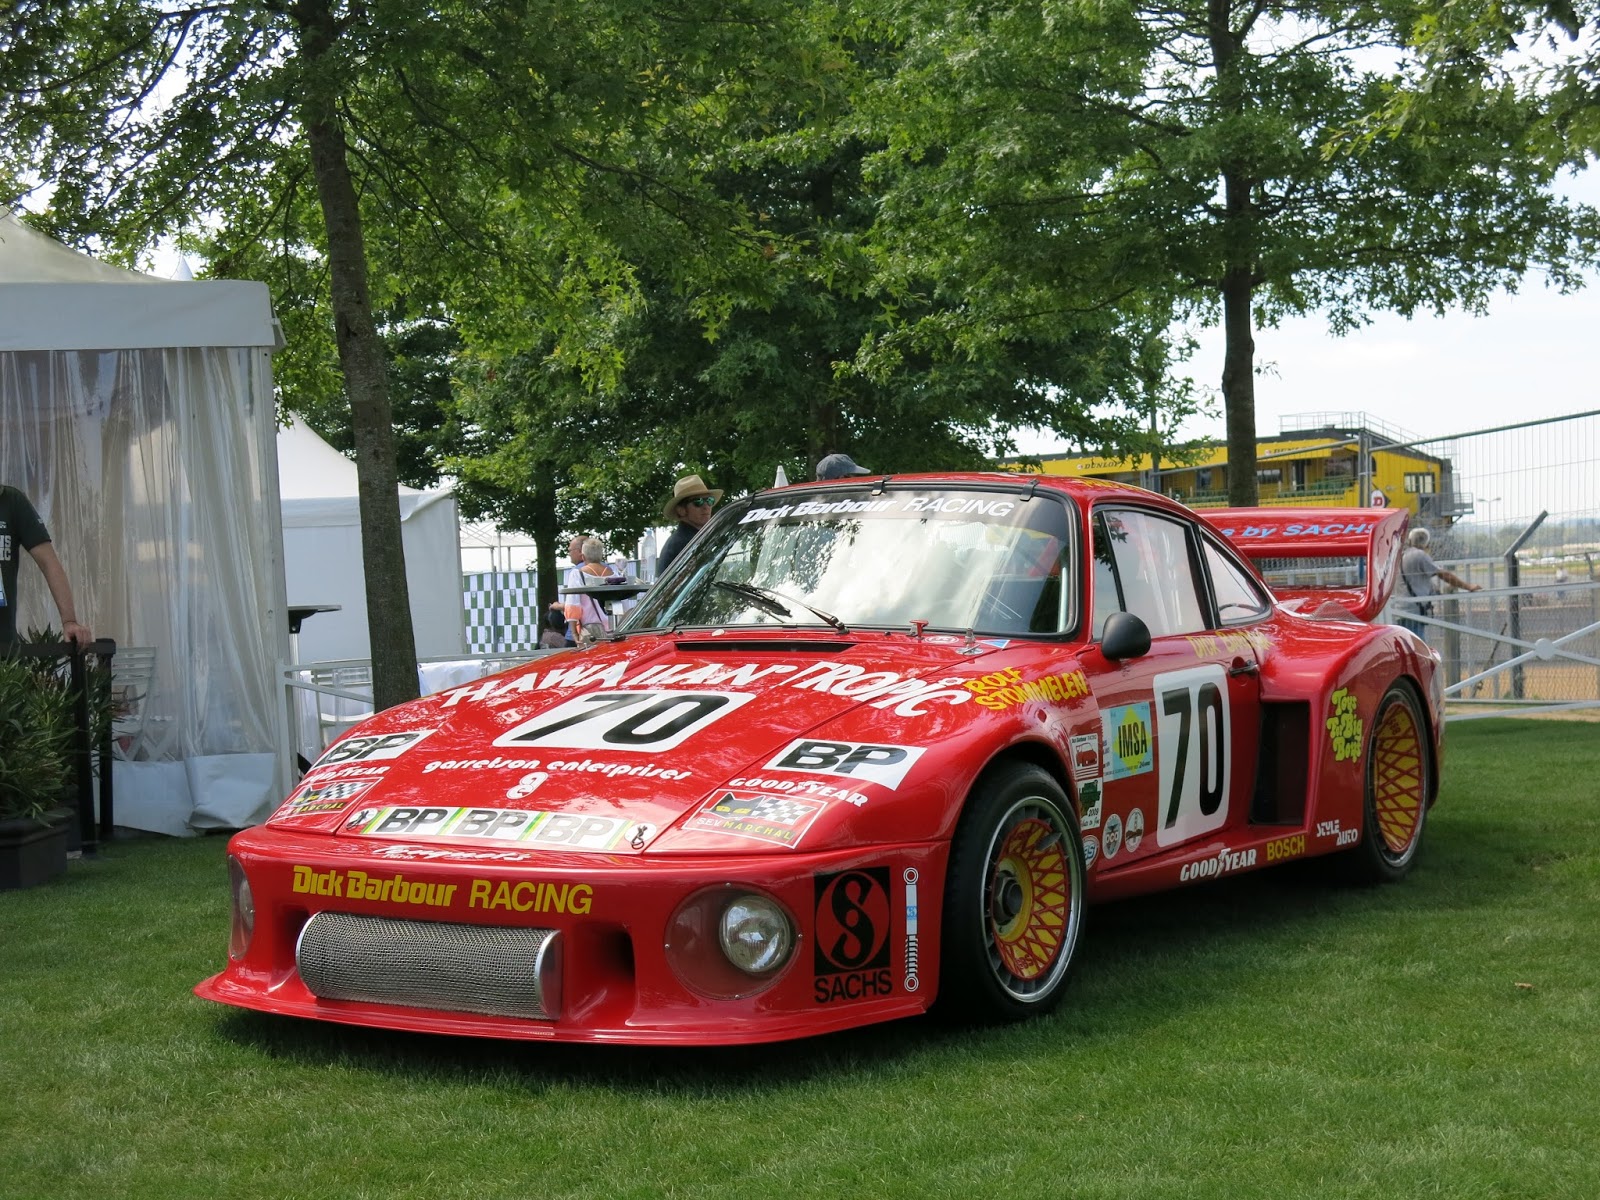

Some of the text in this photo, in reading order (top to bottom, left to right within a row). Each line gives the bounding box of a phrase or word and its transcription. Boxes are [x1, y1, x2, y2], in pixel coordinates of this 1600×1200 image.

[738, 497, 1015, 525] Dick Barbour RACING
[1242, 526, 1277, 538] by
[440, 661, 972, 717] HAWAIIAN TROPIC
[964, 666, 1022, 694] ROLF
[975, 670, 1088, 710] STOMMELEN
[511, 693, 730, 744] 70
[314, 733, 420, 768] BP
[1118, 721, 1148, 758] IMSA
[1162, 682, 1225, 830] 70
[547, 759, 692, 781] enterprises
[776, 741, 907, 774] BP
[728, 778, 868, 807] GOODYEAR
[377, 808, 610, 844] BP BP BP
[722, 821, 792, 840] MARCHAL
[1180, 848, 1257, 881] GOODYEAR
[1266, 835, 1305, 861] BOSCH
[292, 865, 593, 915] Dick Barbour RACING
[814, 969, 893, 1004] SACHS
